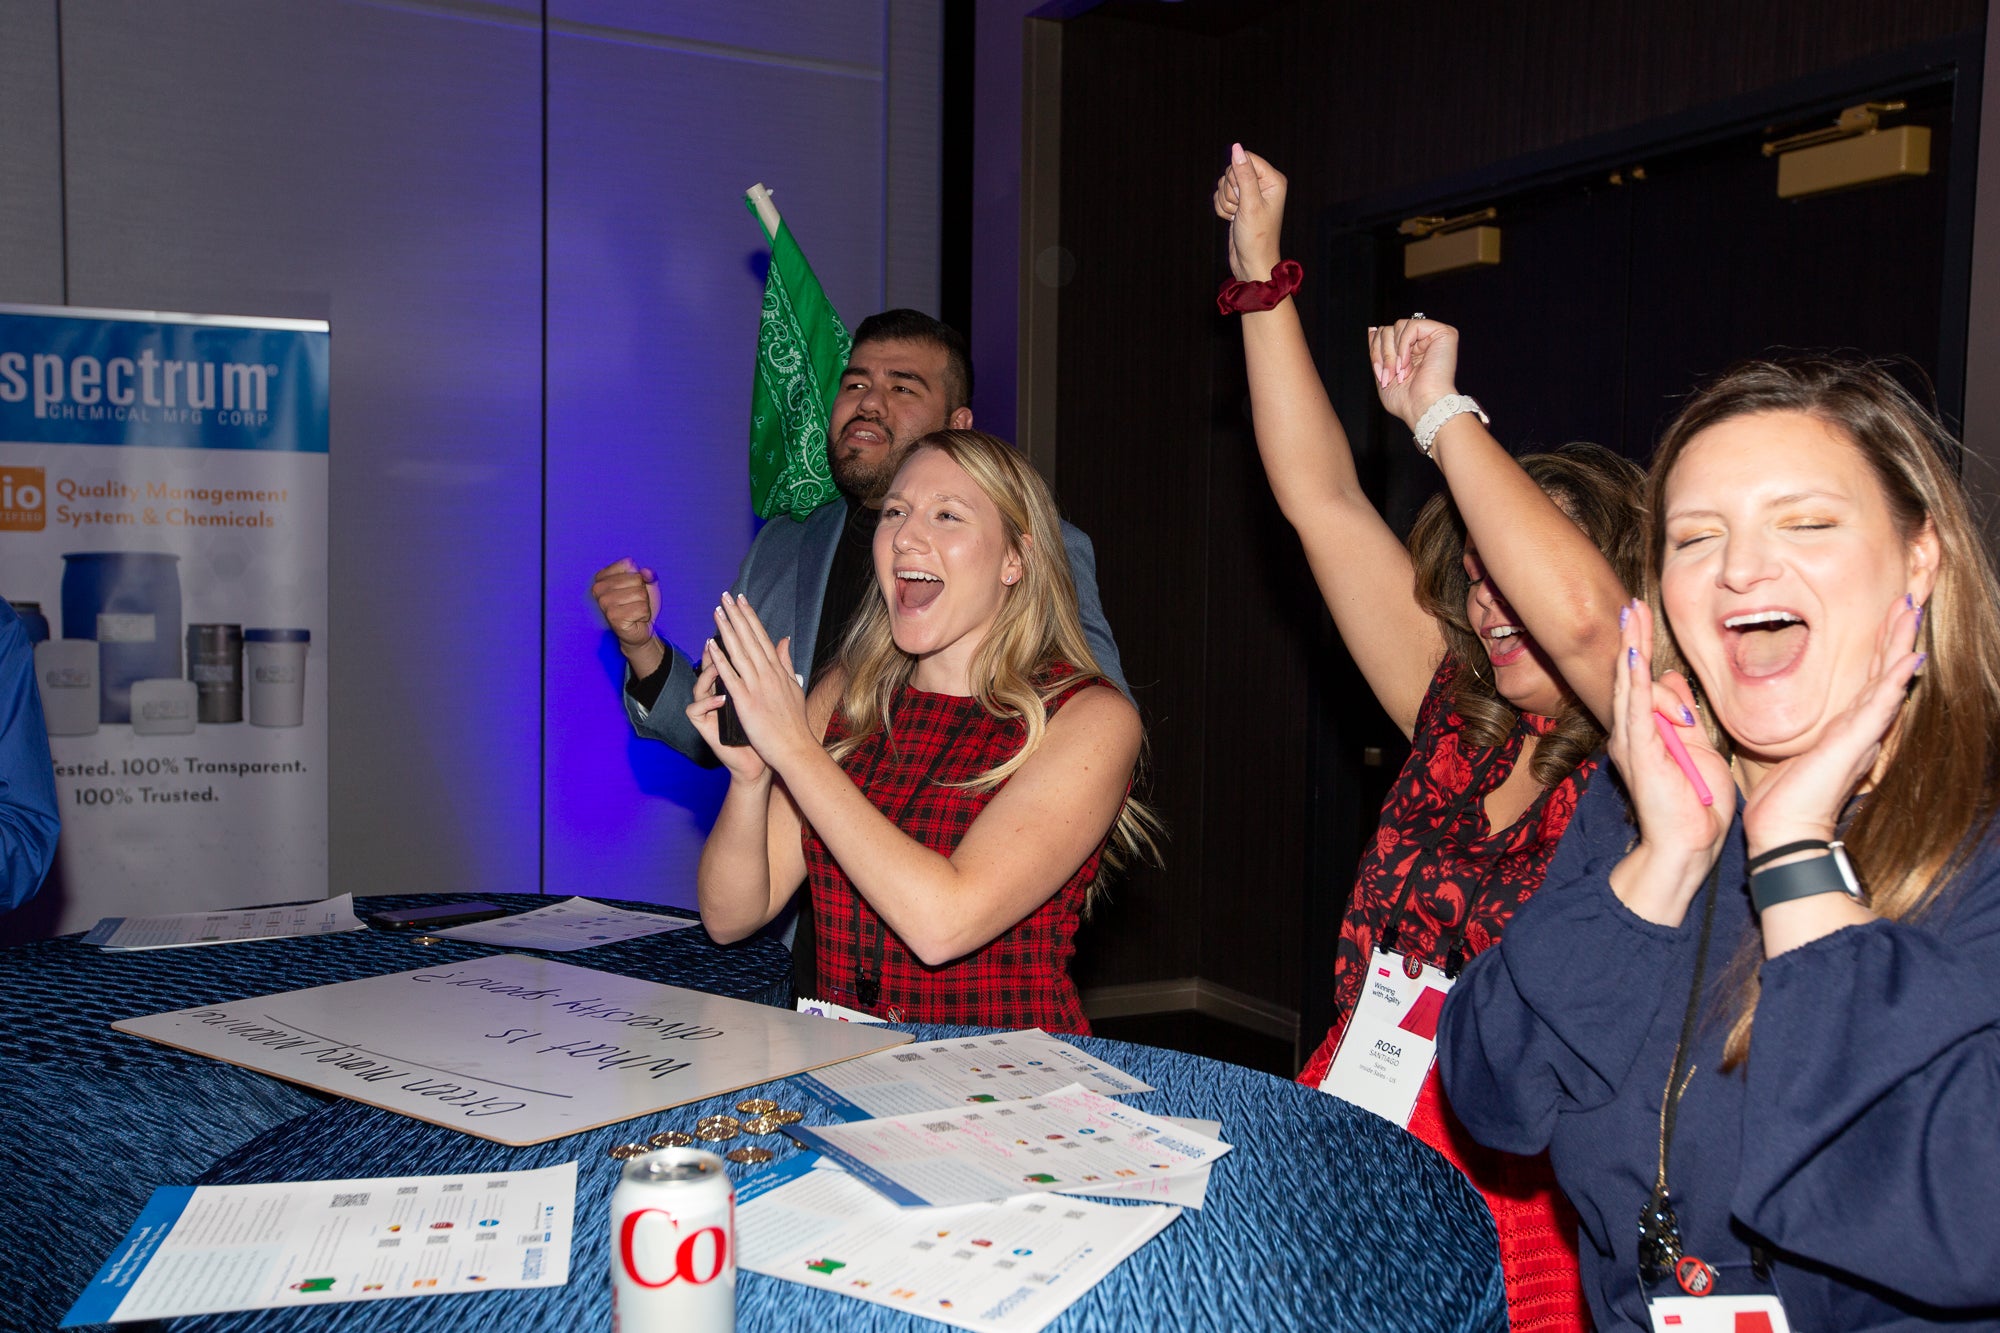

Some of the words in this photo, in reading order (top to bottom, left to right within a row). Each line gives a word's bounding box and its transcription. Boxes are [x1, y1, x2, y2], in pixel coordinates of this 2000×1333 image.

[49, 404, 150, 423] CHEMICAL
[163, 409, 203, 425] MFG
[217, 410, 268, 426] CORP
[56, 479, 139, 503] Quality
[146, 482, 288, 505] Management
[56, 506, 135, 528] System
[142, 508, 160, 525] &
[166, 508, 274, 528] Chemicals
[122, 758, 179, 775] 100%
[184, 758, 307, 778] Transparent.
[75, 788, 133, 805] 100%
[139, 786, 219, 804] Trusted.
[1374, 981, 1396, 996] Winning
[1369, 1050, 1400, 1067] SANTIAGO
[1374, 1039, 1402, 1058] ROSA
[536, 1040, 692, 1079] What
[400, 1078, 527, 1117] Green
